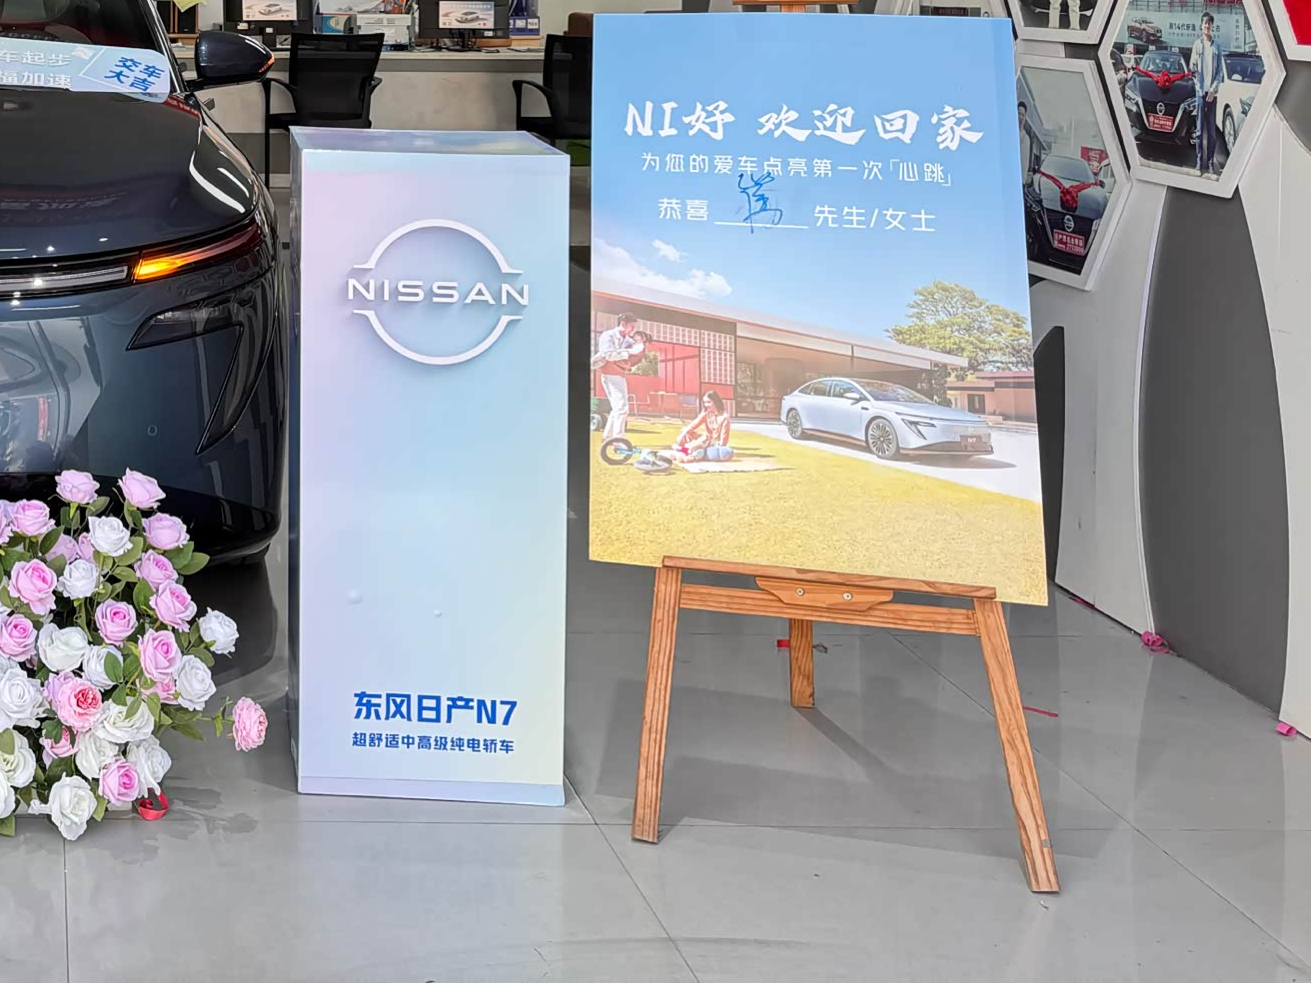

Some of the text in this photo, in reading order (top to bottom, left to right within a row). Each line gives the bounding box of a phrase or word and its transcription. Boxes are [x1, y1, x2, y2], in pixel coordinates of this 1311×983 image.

[104, 70, 156, 92] 大吉
[115, 56, 166, 79] 交车
[624, 100, 984, 151] NI好 欢迎回家
[641, 152, 951, 186] 为您的爱车点亮第一次「心跳」
[658, 198, 936, 231] 恭喜 先生/女士
[347, 278, 529, 307] NISSAN
[353, 691, 518, 726] 东风日产N7
[352, 731, 515, 755] 超舒适中高级纯电轿车
